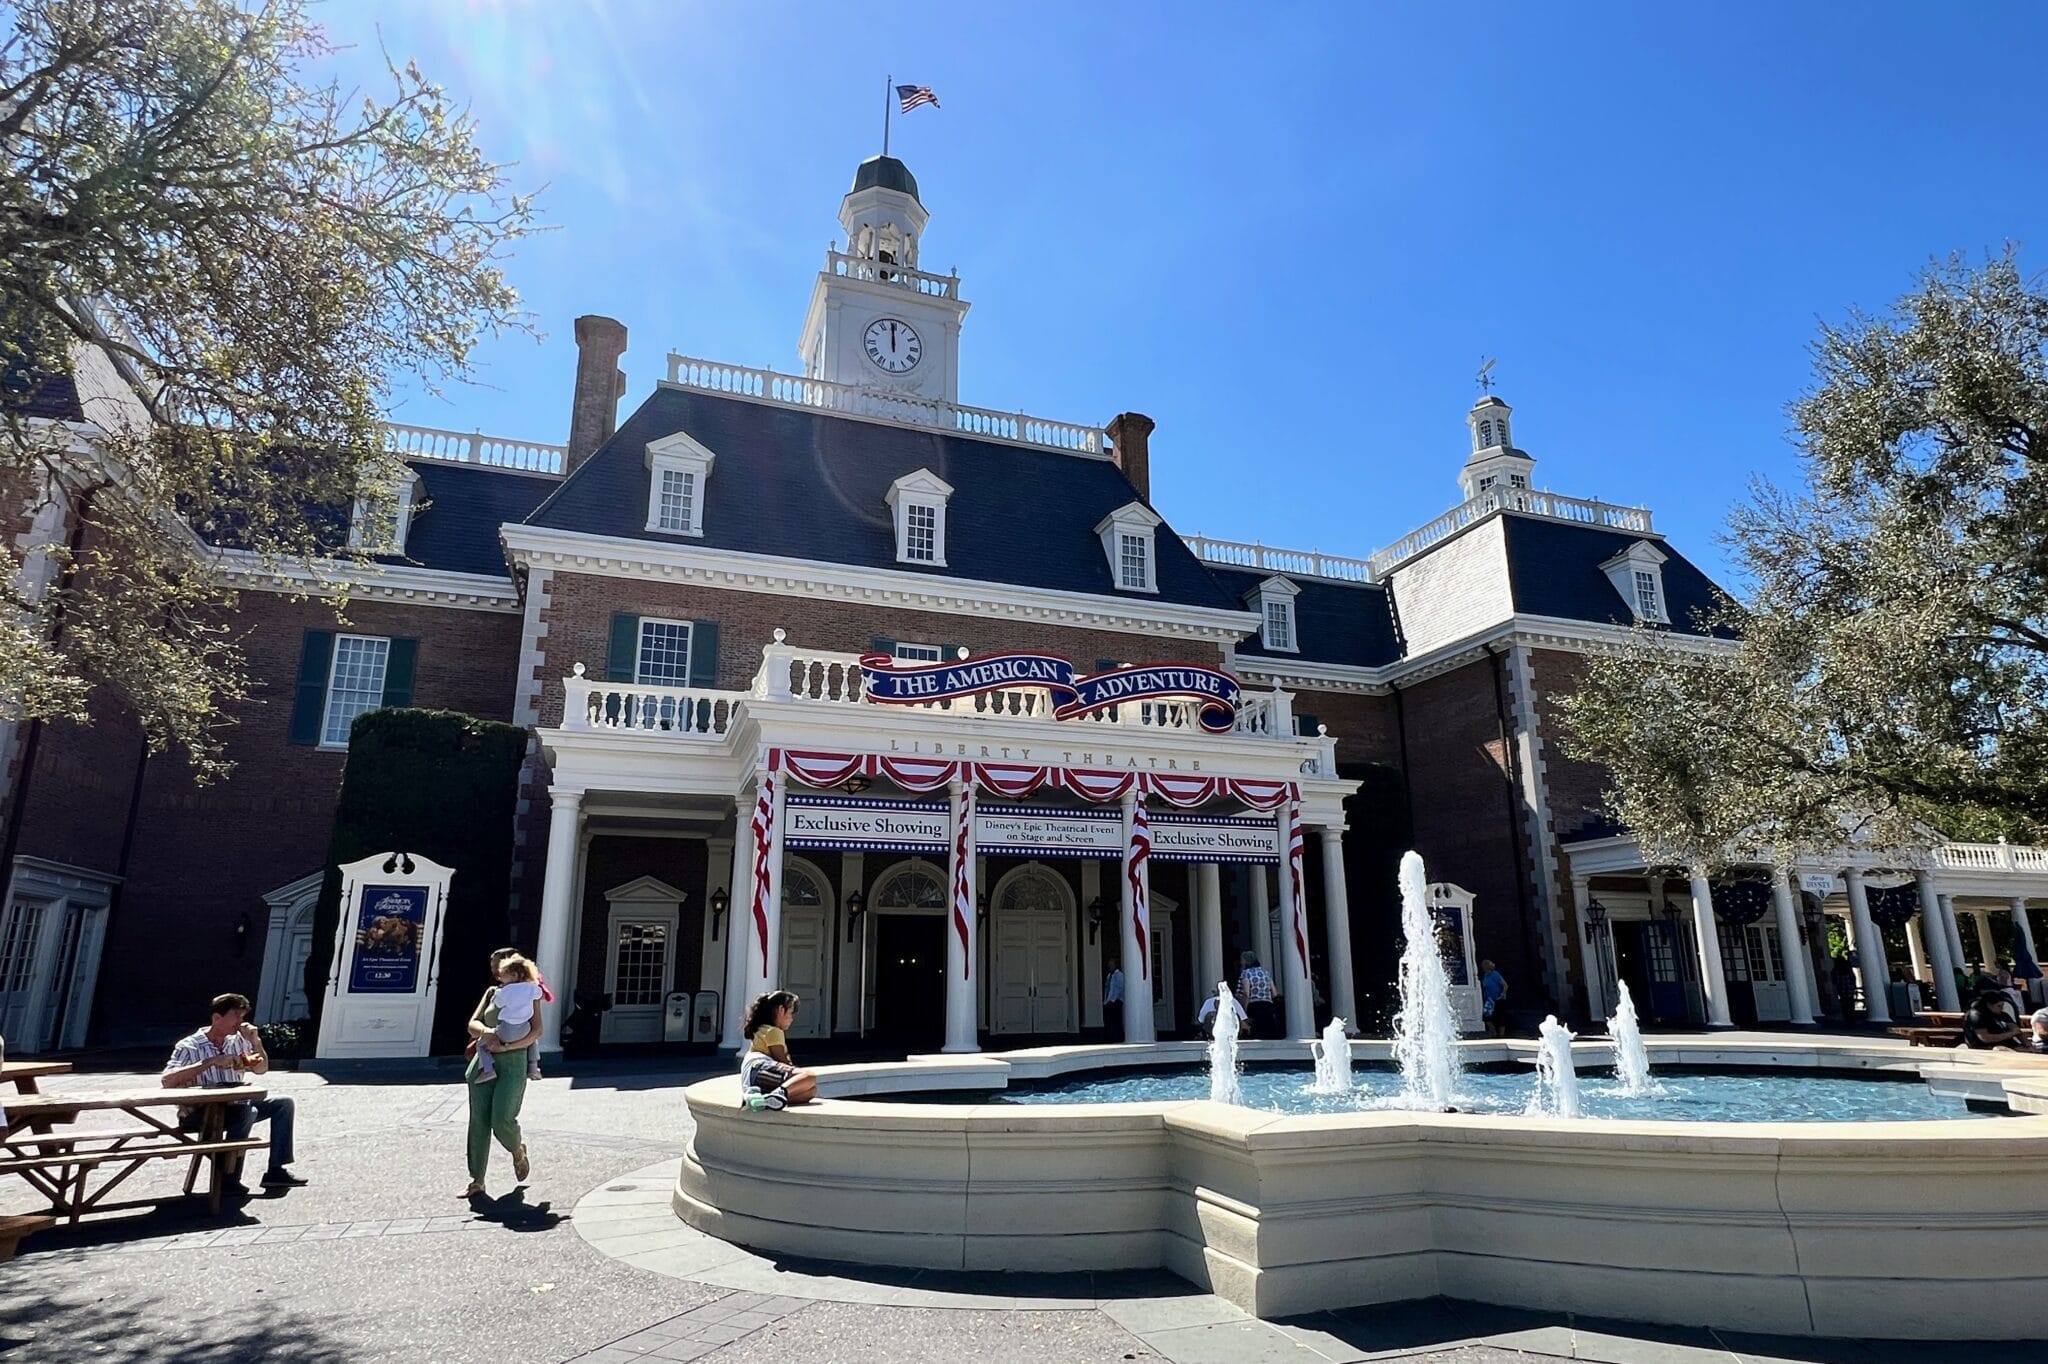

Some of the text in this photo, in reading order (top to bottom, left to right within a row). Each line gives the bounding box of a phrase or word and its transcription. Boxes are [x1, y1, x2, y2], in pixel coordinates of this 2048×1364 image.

[890, 660, 1220, 701] THE AMERICAN ADVENTURE
[891, 740, 1200, 771] LIBERTY THEATRE
[794, 814, 942, 838] Exclusive Showing
[985, 820, 1115, 834] Disney's Epic Theatrical Event
[1006, 832, 1094, 843] on Stage and Screen
[1153, 830, 1273, 851] Exclusive Showing
